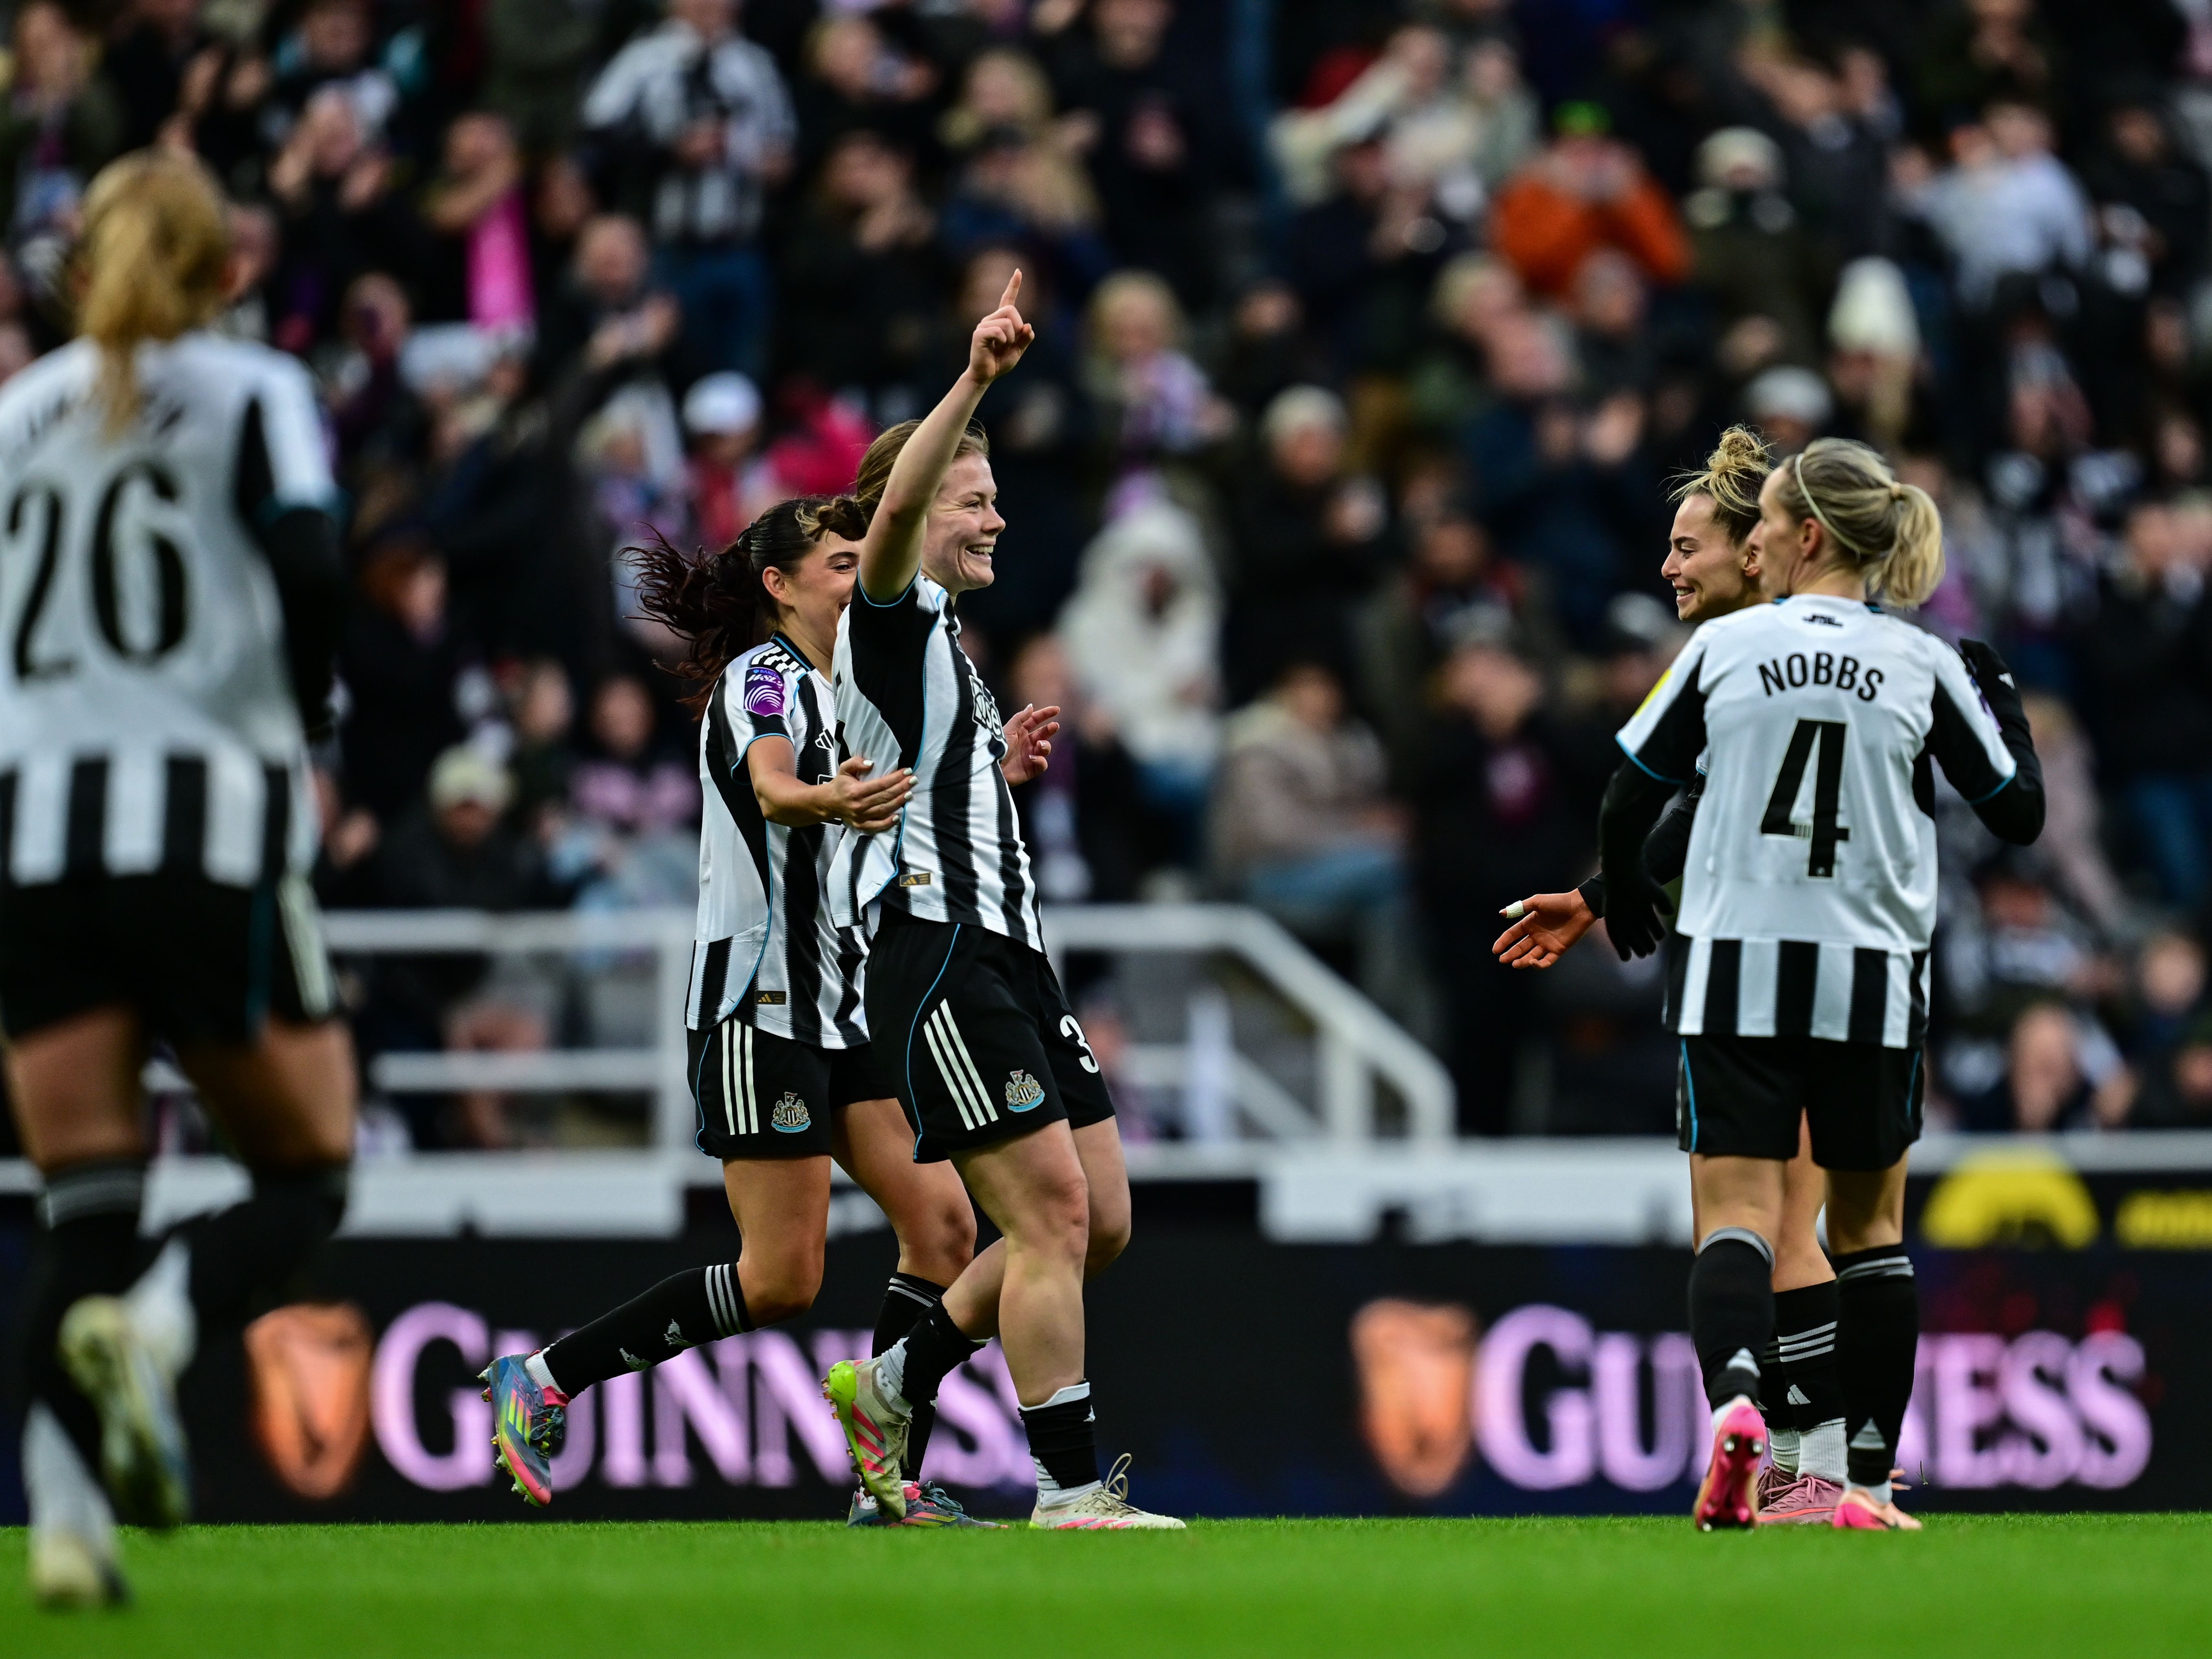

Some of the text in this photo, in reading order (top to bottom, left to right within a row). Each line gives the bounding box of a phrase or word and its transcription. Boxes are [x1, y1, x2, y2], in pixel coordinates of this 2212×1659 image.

[6, 460, 188, 686] 26
[1759, 652, 1884, 702] NOBBS
[1761, 718, 1850, 877] 4
[1471, 1303, 2152, 1492] GUESS
